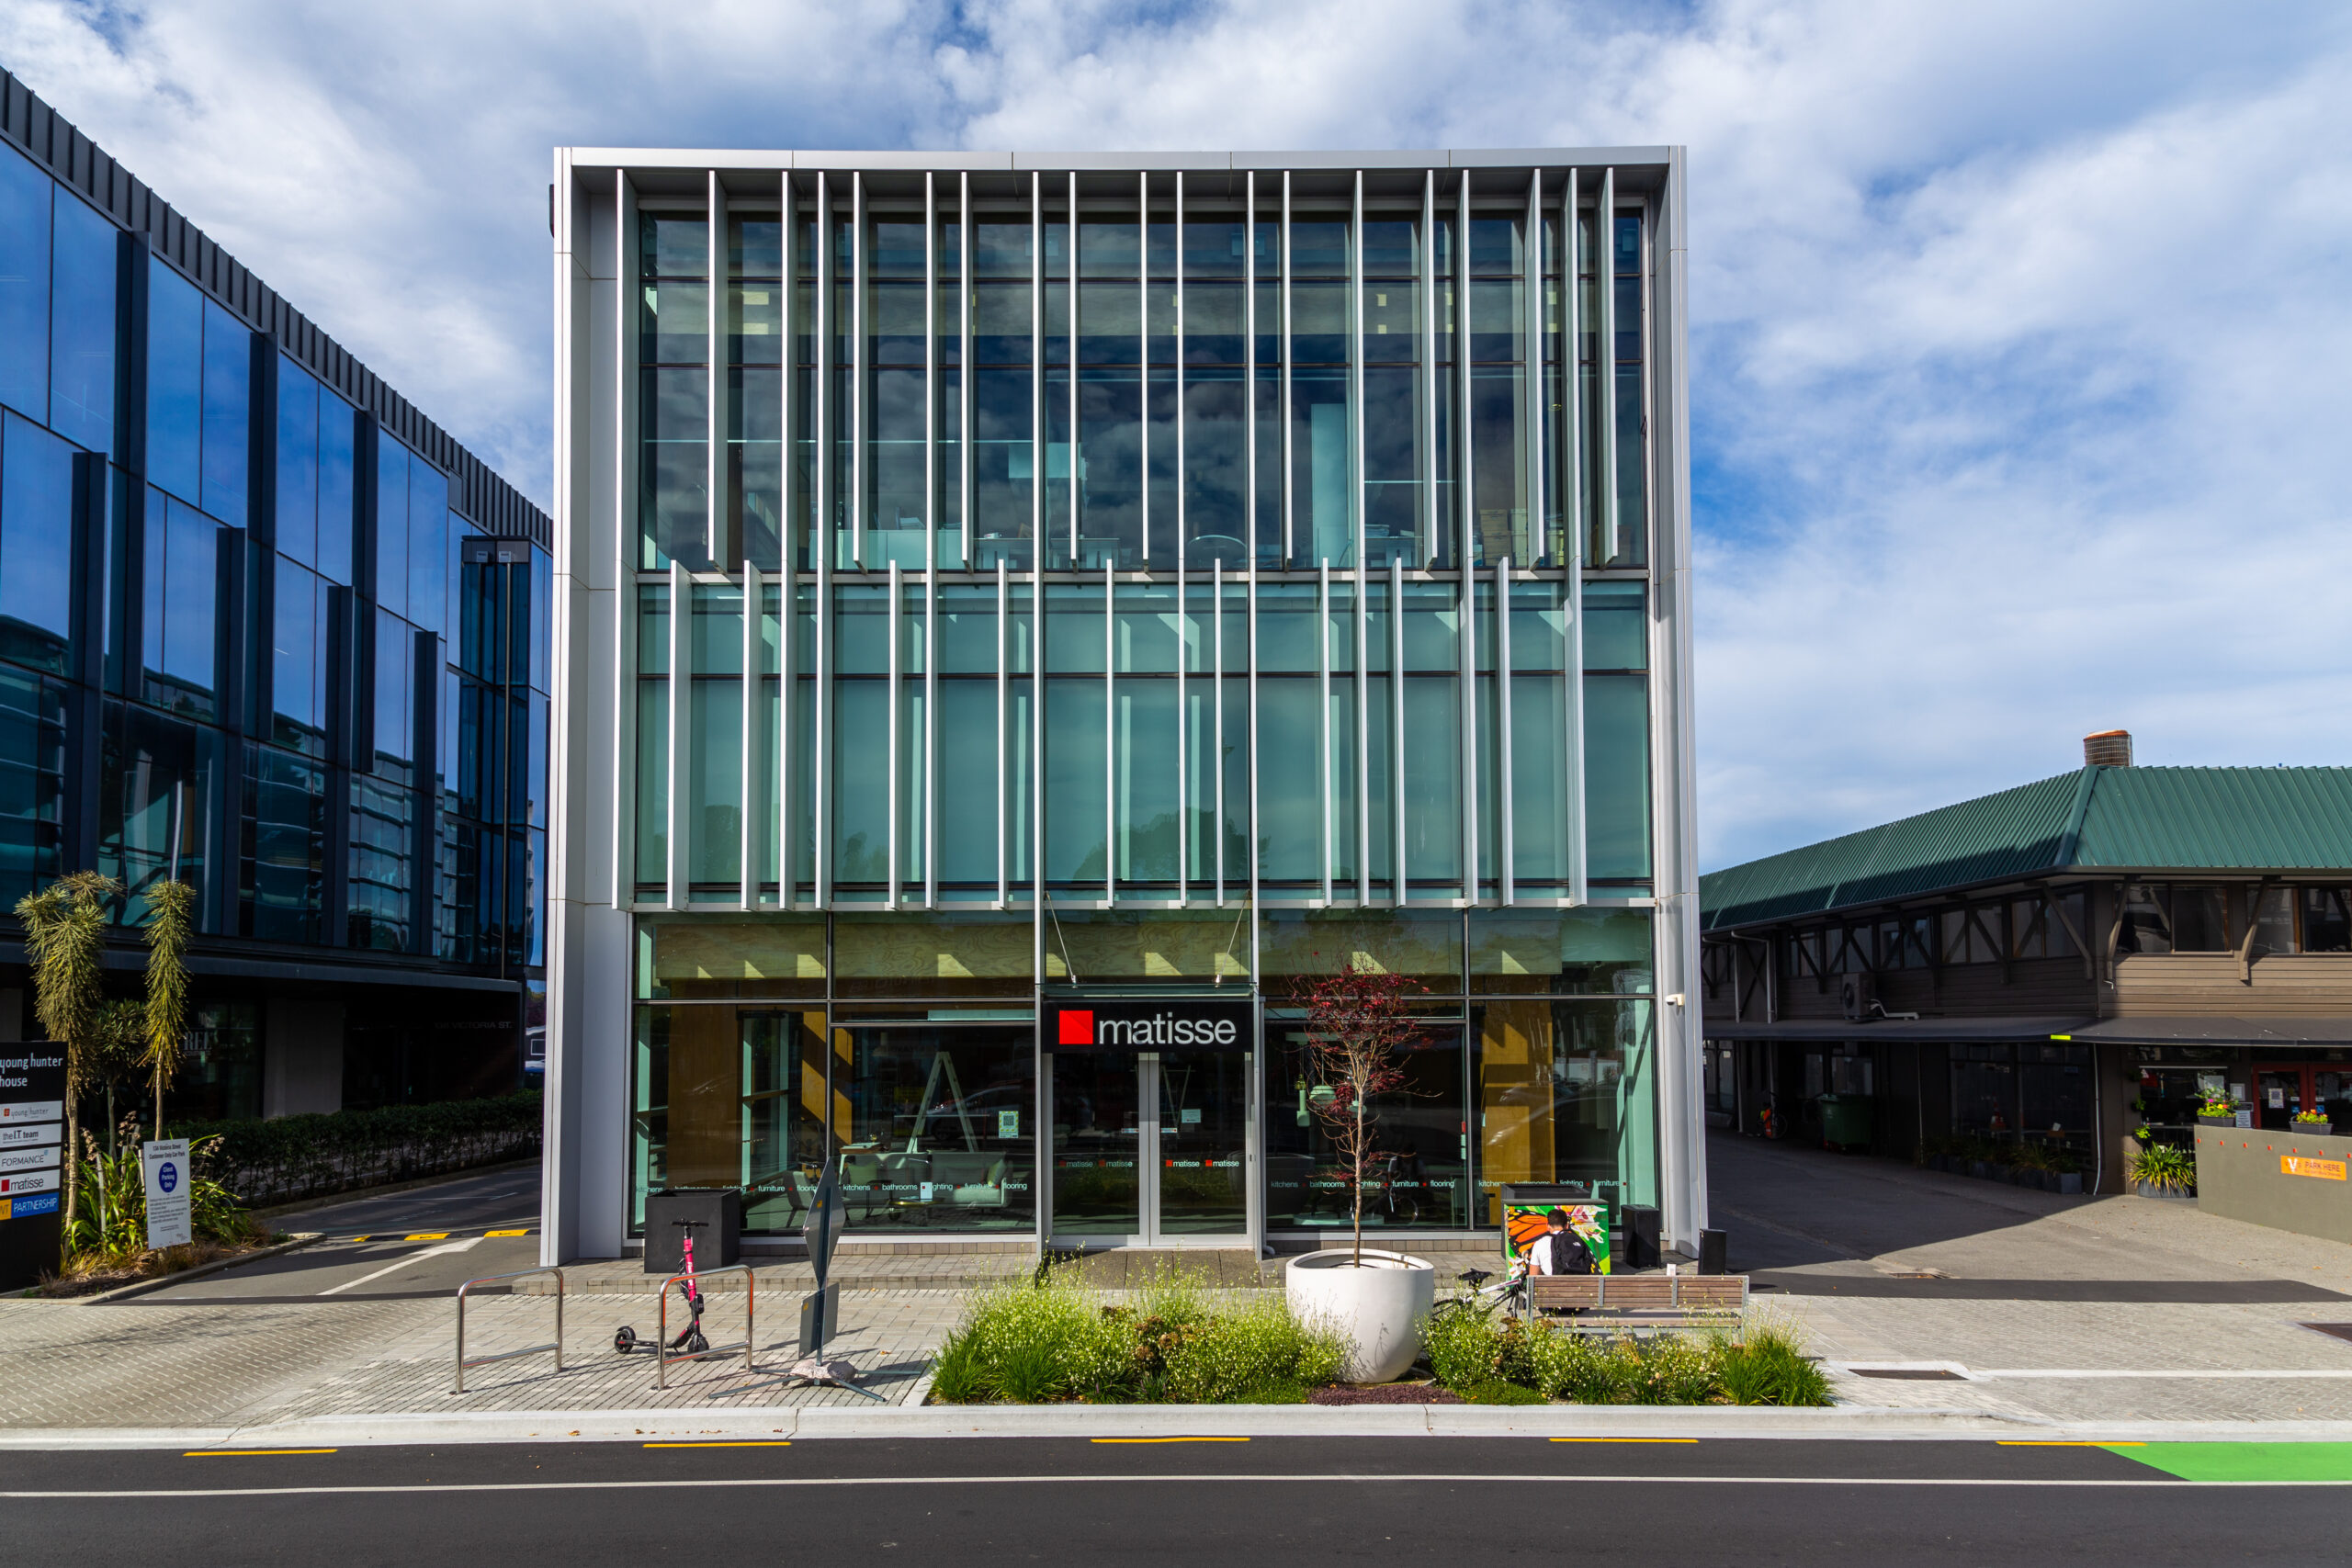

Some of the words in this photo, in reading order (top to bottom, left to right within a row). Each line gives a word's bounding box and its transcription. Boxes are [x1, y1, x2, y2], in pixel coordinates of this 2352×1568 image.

[1099, 1011, 1237, 1044] matisse
[0, 1058, 29, 1075] young
[30, 1052, 63, 1067] hunter
[0, 1075, 28, 1088] house
[3, 1132, 13, 1141] the
[22, 1131, 39, 1139] team
[1, 1154, 44, 1168] FORMANCE
[1066, 1159, 1093, 1168] matisse
[1105, 1159, 1133, 1168] matisse
[1172, 1159, 1200, 1168] matisse
[1212, 1159, 1239, 1168] matisse
[11, 1177, 44, 1191] matisse
[758, 1184, 786, 1192] furniture
[842, 1183, 871, 1191] kitchens
[881, 1183, 918, 1191] bathrooms
[1001, 1182, 1028, 1191] flooring
[1271, 1180, 1298, 1189] kitchens
[1309, 1179, 1345, 1189] bathrooms
[1391, 1179, 1419, 1188] furniture
[1430, 1179, 1454, 1190] flooring
[13, 1197, 58, 1213] PARTNERSHIP
